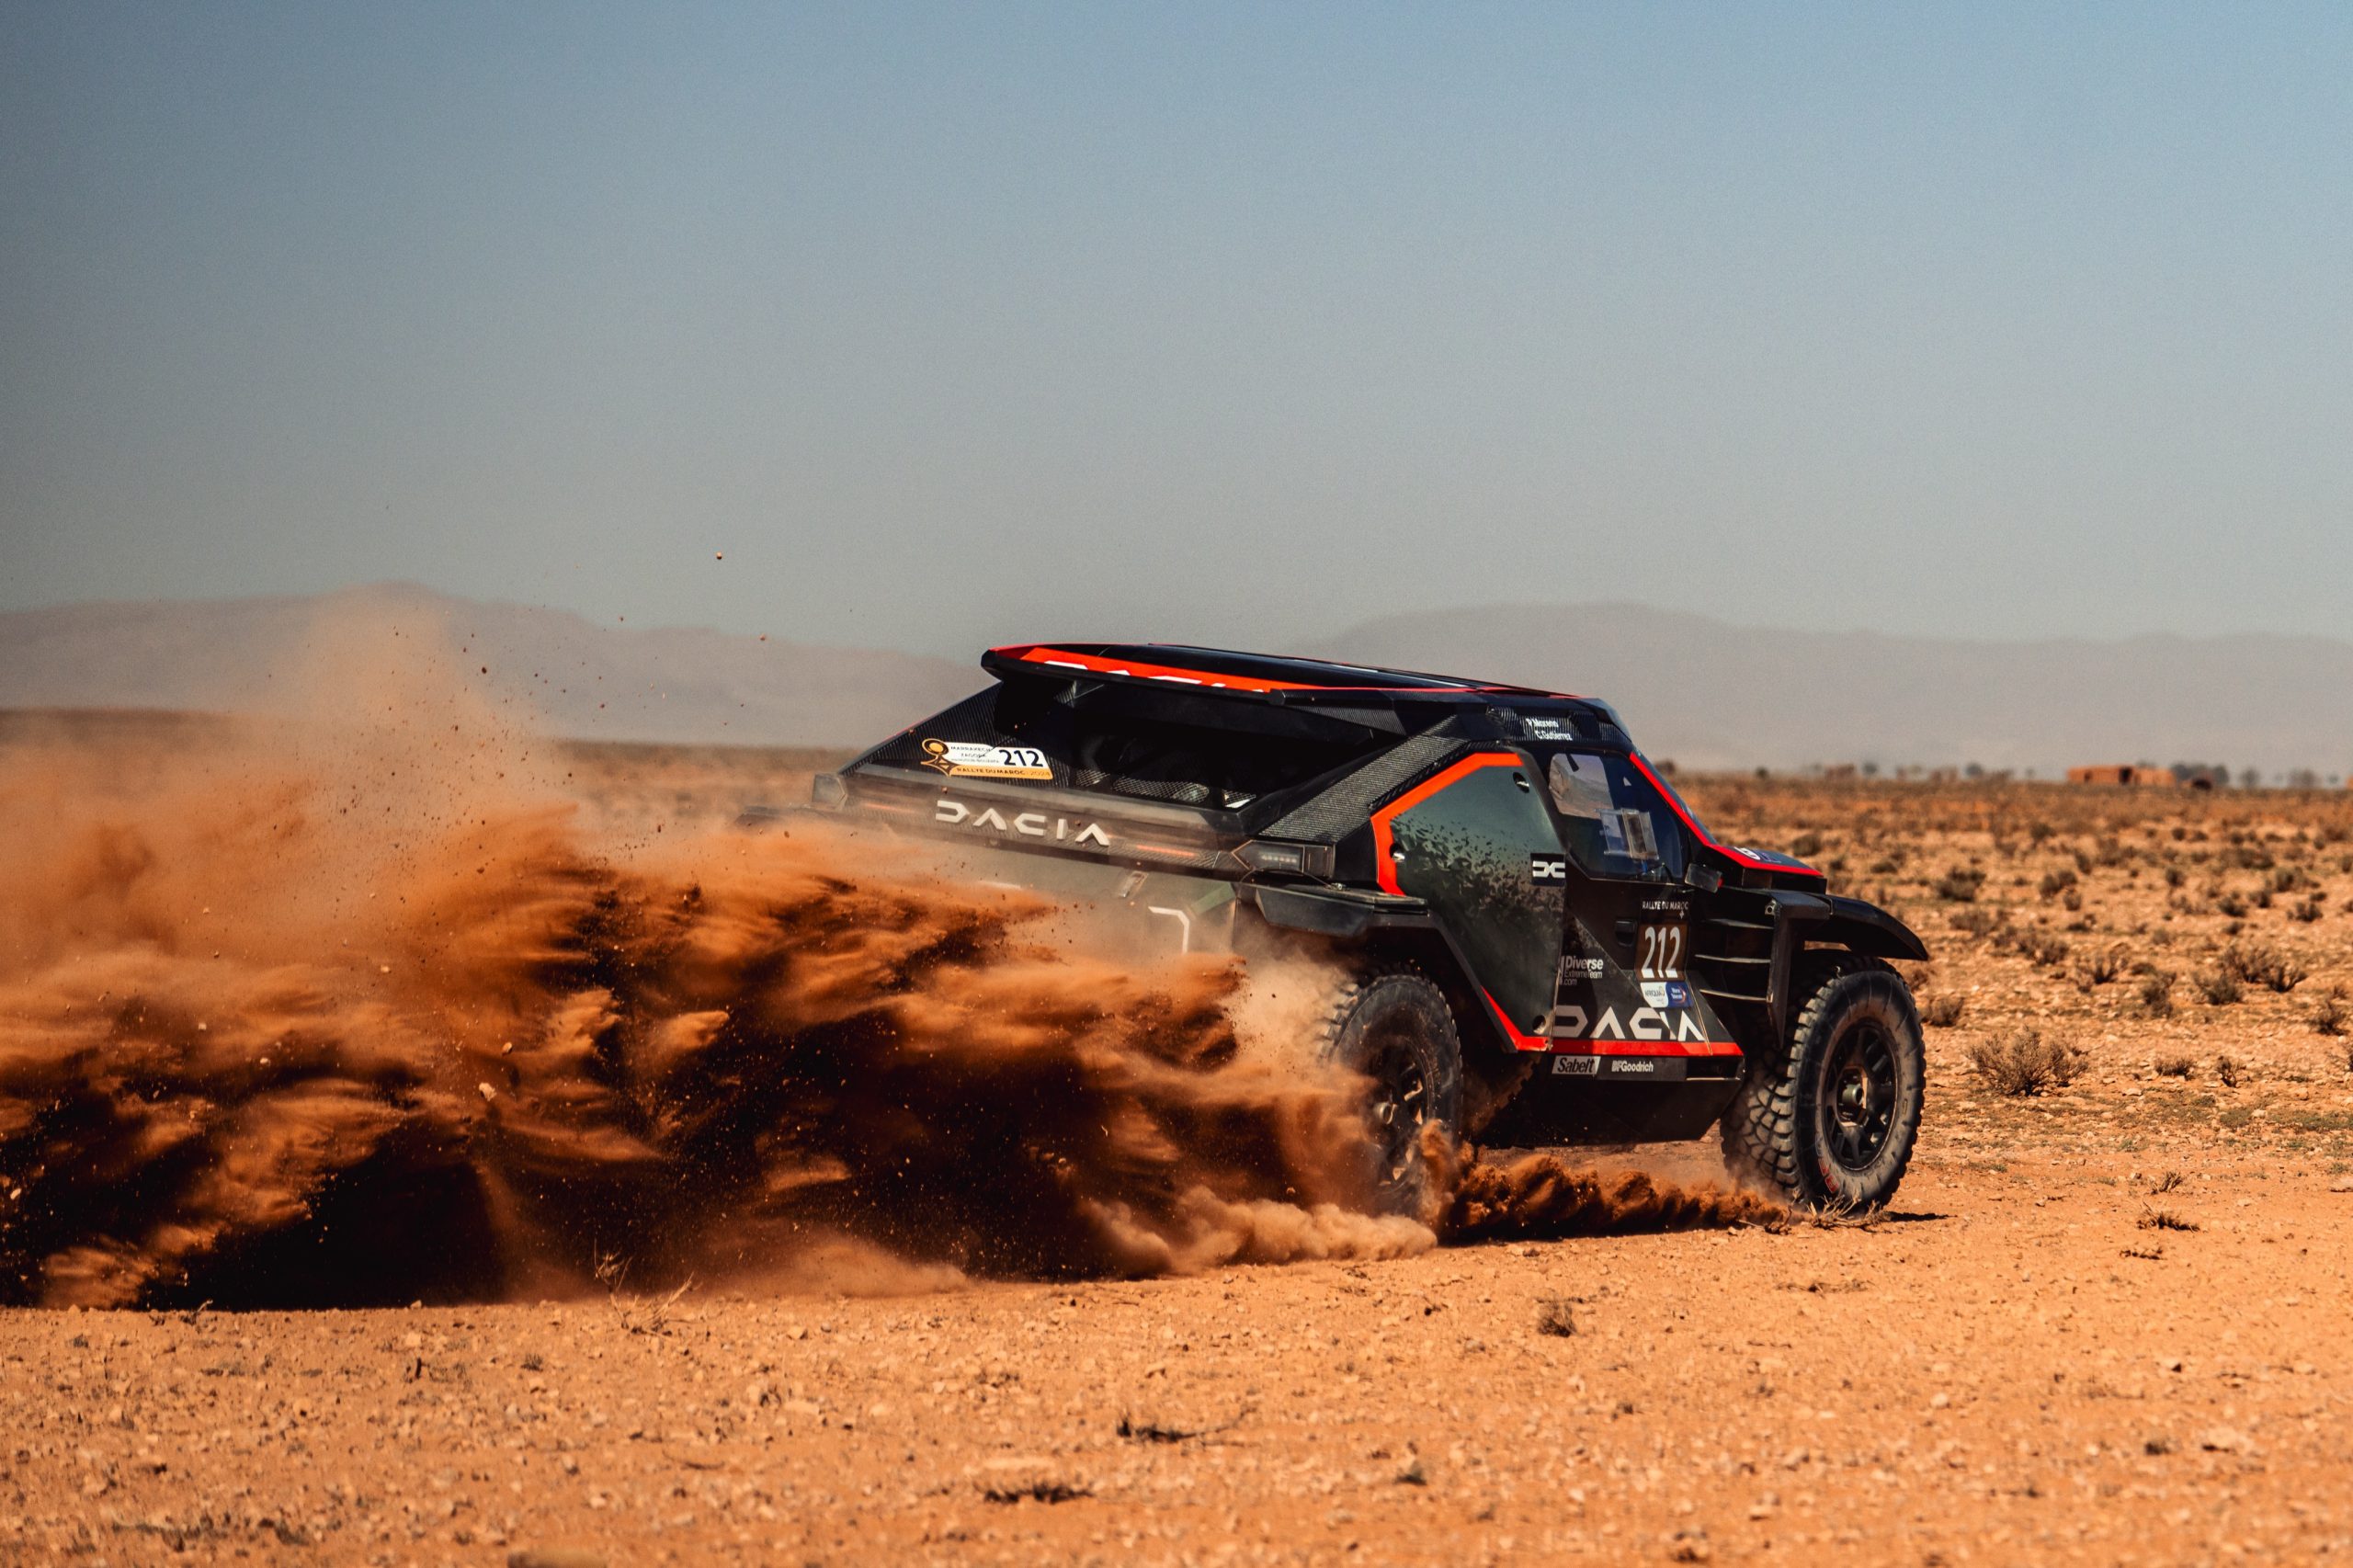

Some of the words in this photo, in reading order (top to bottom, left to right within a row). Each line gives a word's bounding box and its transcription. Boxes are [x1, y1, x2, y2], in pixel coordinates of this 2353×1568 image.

[998, 749, 1043, 767] 212
[935, 800, 1110, 846] DACIA
[1642, 901, 1661, 910] RALLYE
[1661, 901, 1669, 910] DU
[1641, 926, 1680, 978] 212
[1565, 955, 1604, 971] Diverse
[1554, 1005, 1705, 1041] DACIA
[1558, 1058, 1595, 1074] Sabelt
[1611, 1060, 1654, 1073] BFGoodrich
